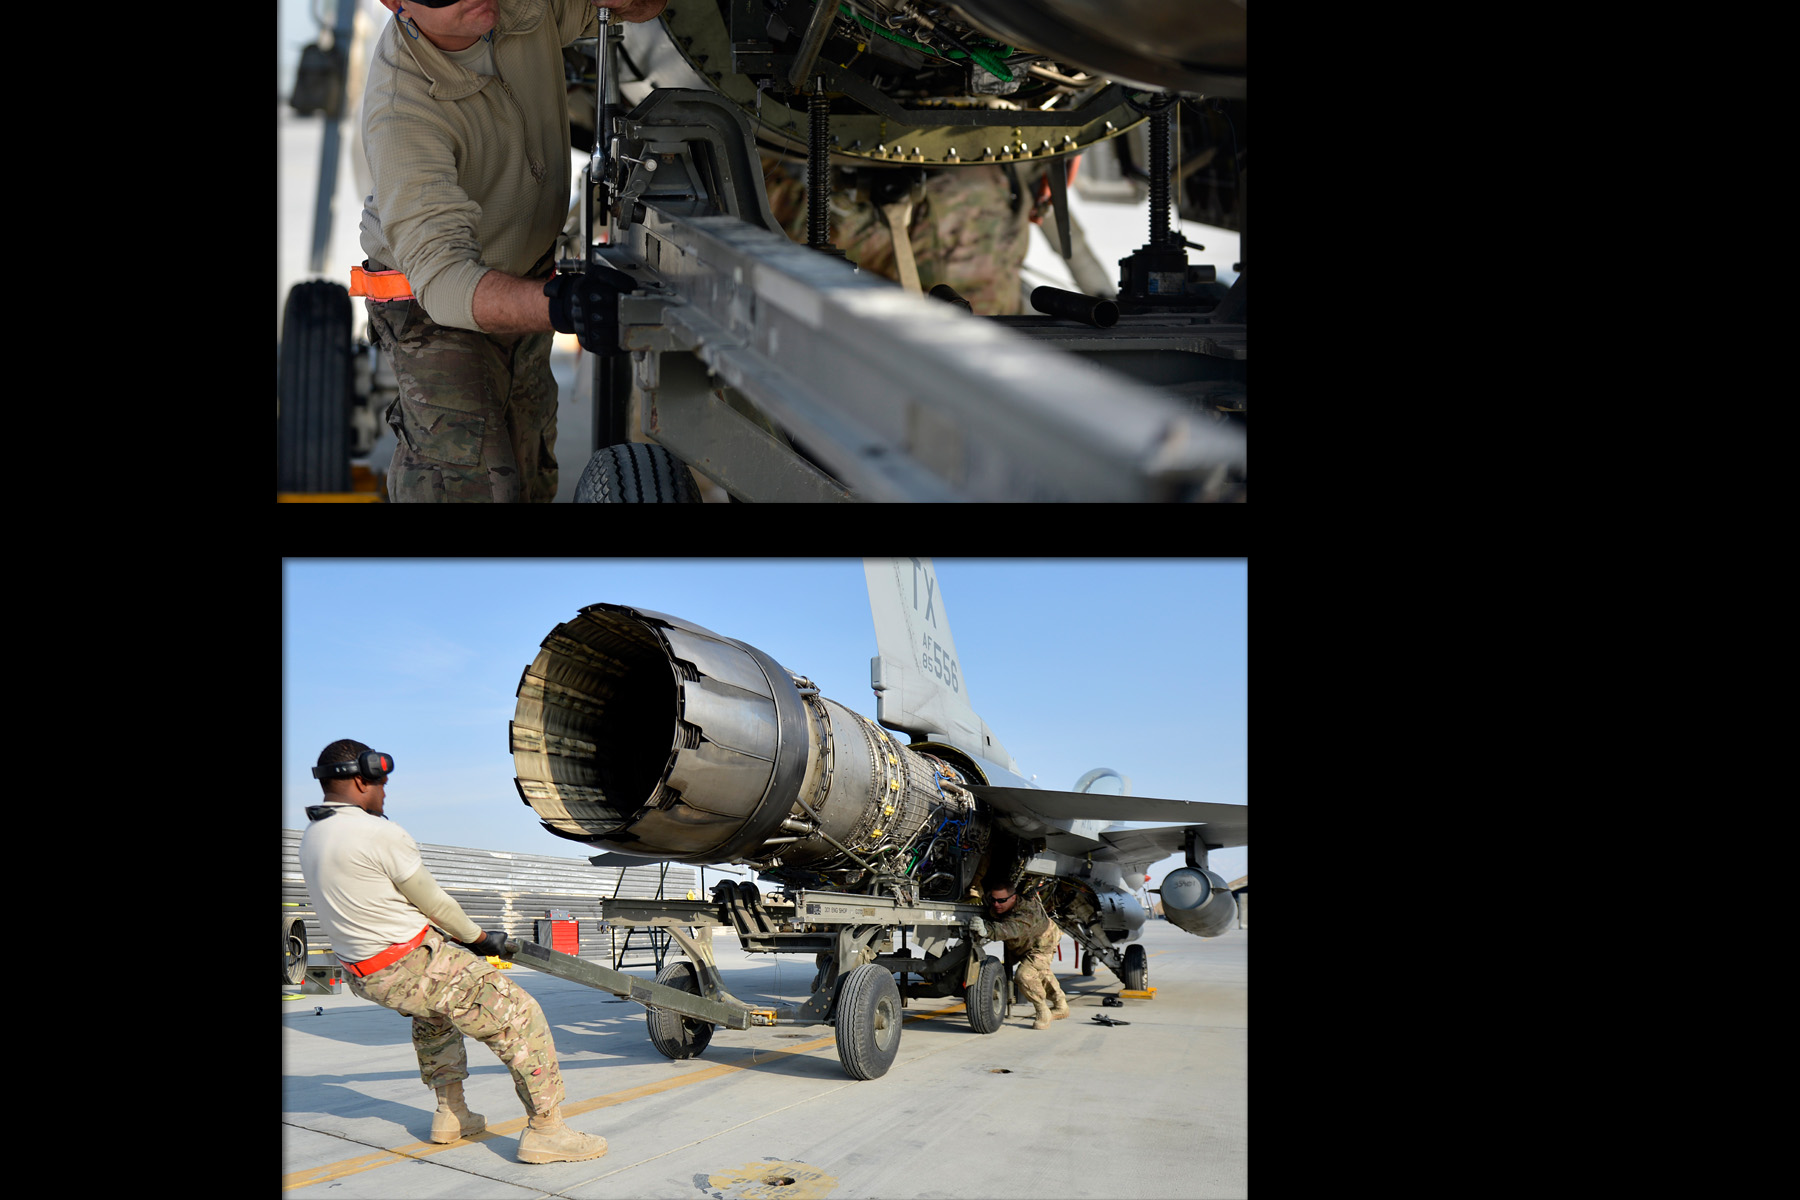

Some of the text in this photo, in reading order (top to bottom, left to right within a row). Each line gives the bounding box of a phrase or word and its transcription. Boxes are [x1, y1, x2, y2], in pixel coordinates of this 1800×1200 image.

[908, 557, 937, 629] TX
[922, 632, 933, 650] AF
[922, 653, 934, 673] 85
[933, 641, 959, 693] 556
